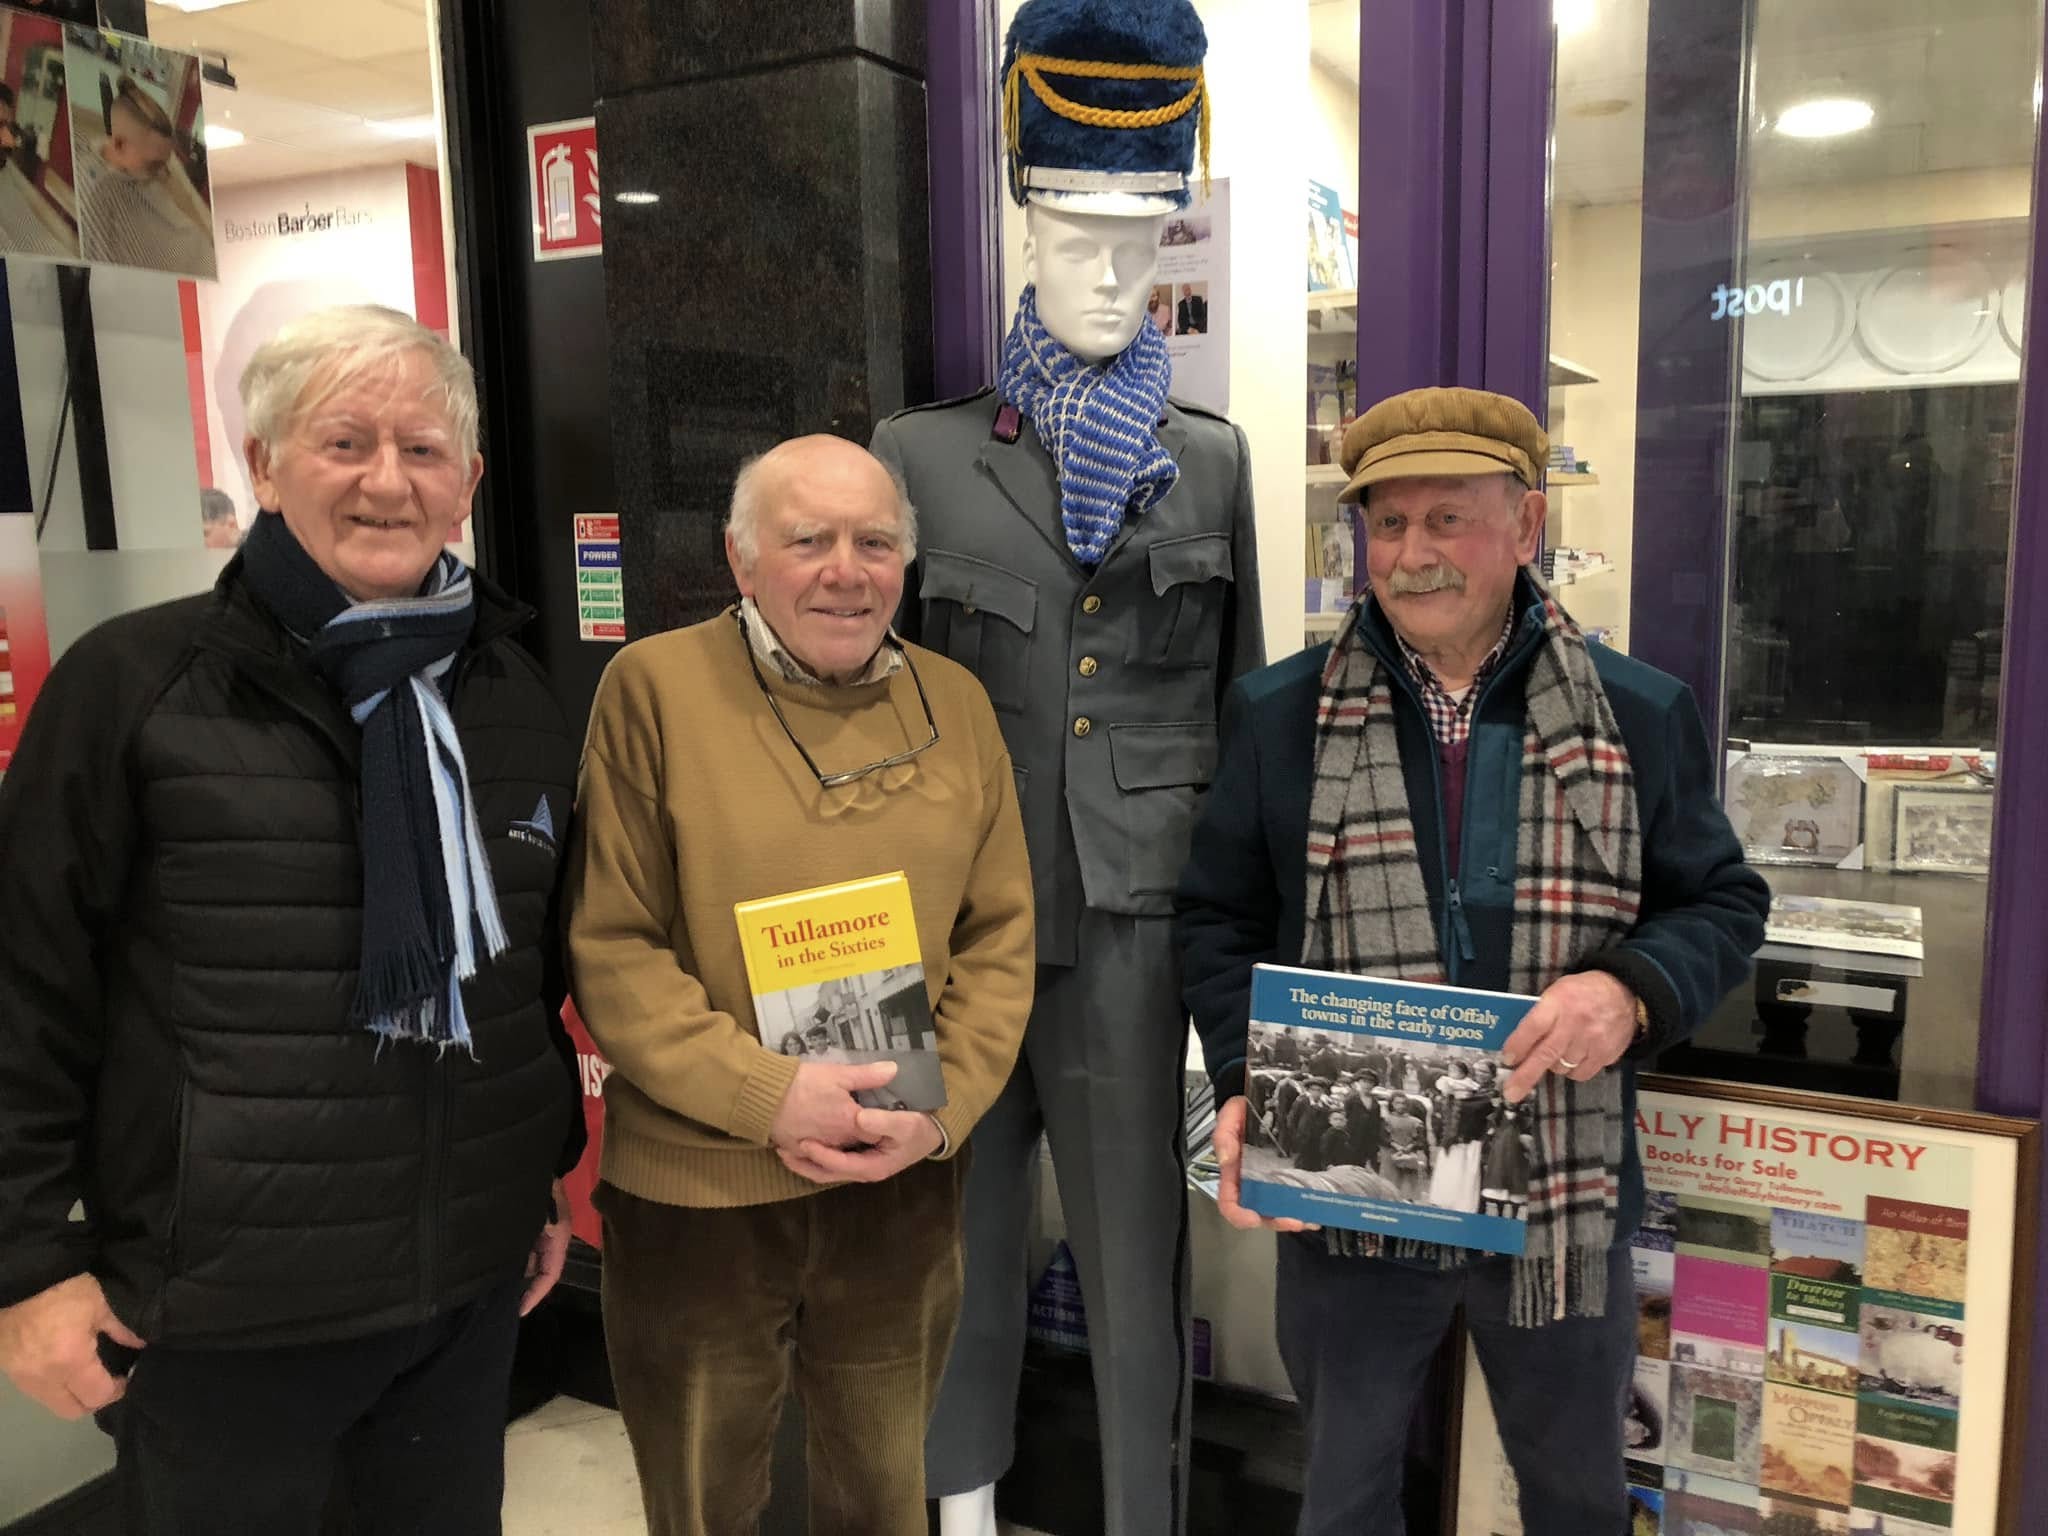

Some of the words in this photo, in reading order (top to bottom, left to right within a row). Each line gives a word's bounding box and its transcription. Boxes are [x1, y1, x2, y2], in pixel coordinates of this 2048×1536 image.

[583, 550, 618, 562] POWDER
[761, 910, 890, 949] Tullamore
[777, 954, 795, 969] in
[799, 947, 827, 965] the
[829, 936, 886, 958] Sixties
[1289, 988, 1319, 1004] The
[1321, 992, 1393, 1017] changing
[1395, 1000, 1428, 1018] face
[1430, 1005, 1450, 1020] of
[1450, 1007, 1499, 1029] Offaly
[1301, 1008, 1348, 1024] towns
[1350, 1011, 1366, 1026] in
[1370, 1014, 1394, 1030] the
[1397, 1018, 1436, 1036] early
[1439, 1024, 1484, 1041] 1900s
[1719, 1114, 1927, 1171] HISTORY
[1646, 1144, 1708, 1167] Books
[1715, 1153, 1745, 1171] for
[1752, 1159, 1798, 1180] Sale
